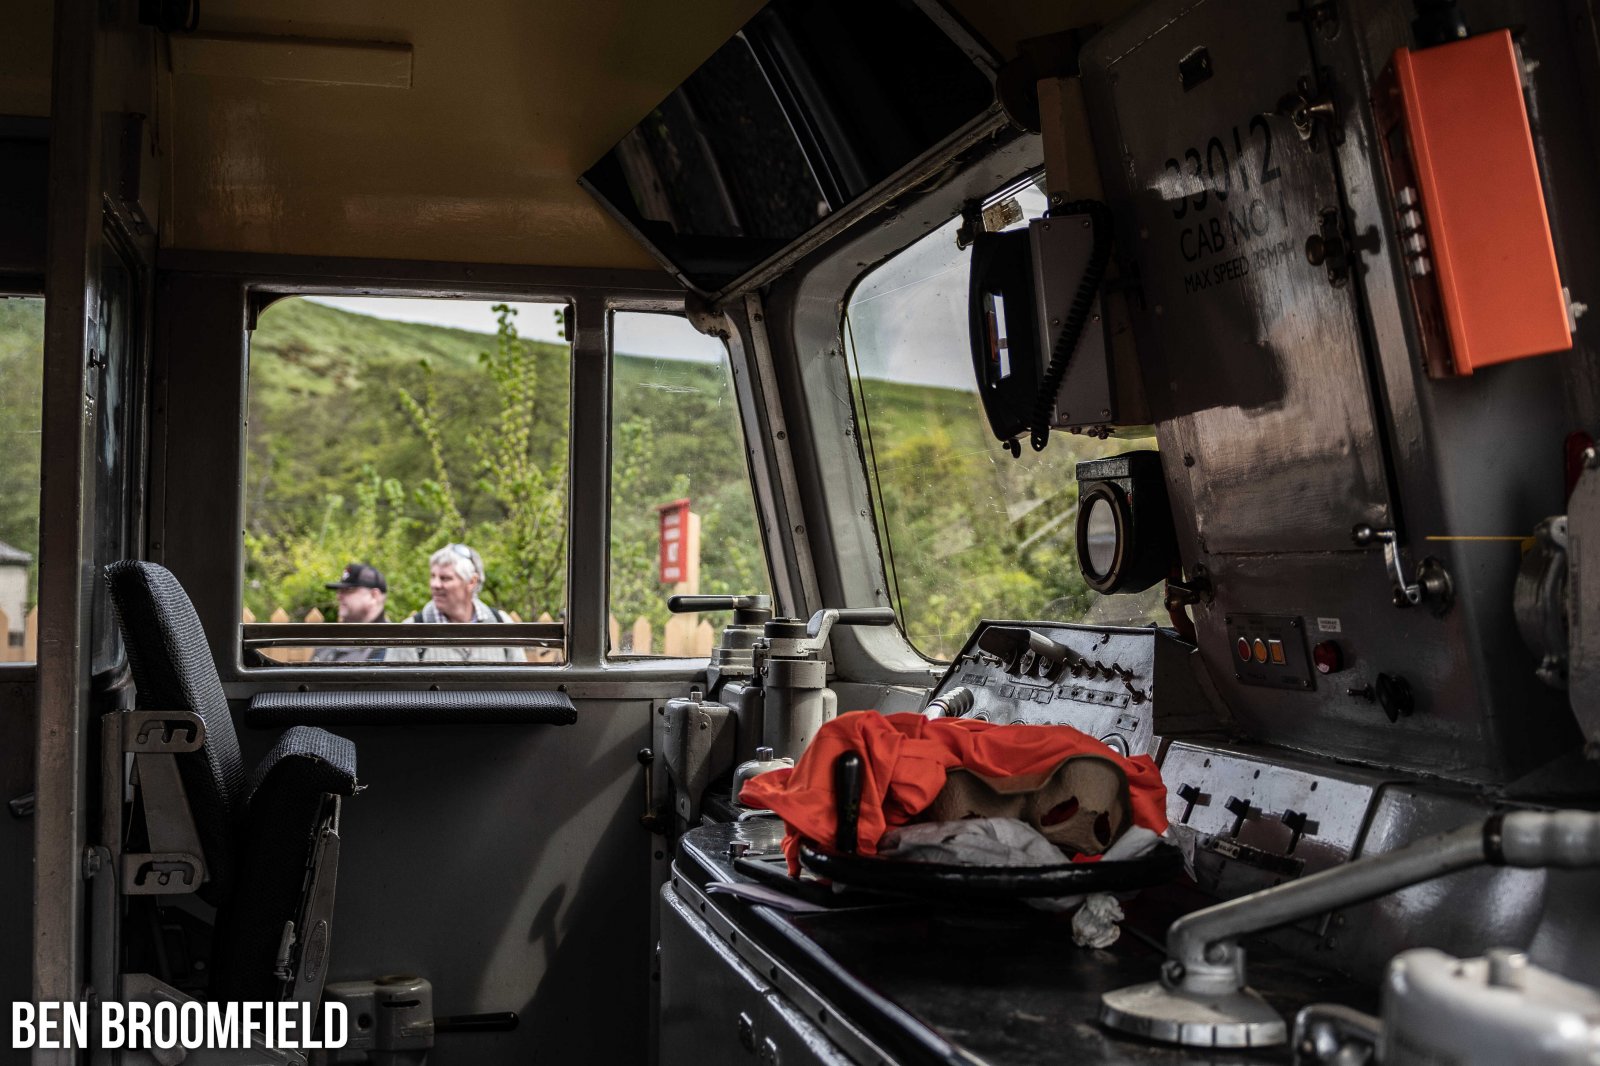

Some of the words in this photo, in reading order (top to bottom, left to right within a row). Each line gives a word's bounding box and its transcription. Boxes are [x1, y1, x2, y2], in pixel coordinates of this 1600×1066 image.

[1165, 114, 1282, 219] 33012
[1180, 217, 1225, 262] CAB
[1228, 199, 1270, 246] NO
[1184, 268, 1212, 294] MAX
[1213, 255, 1249, 284] SPEED
